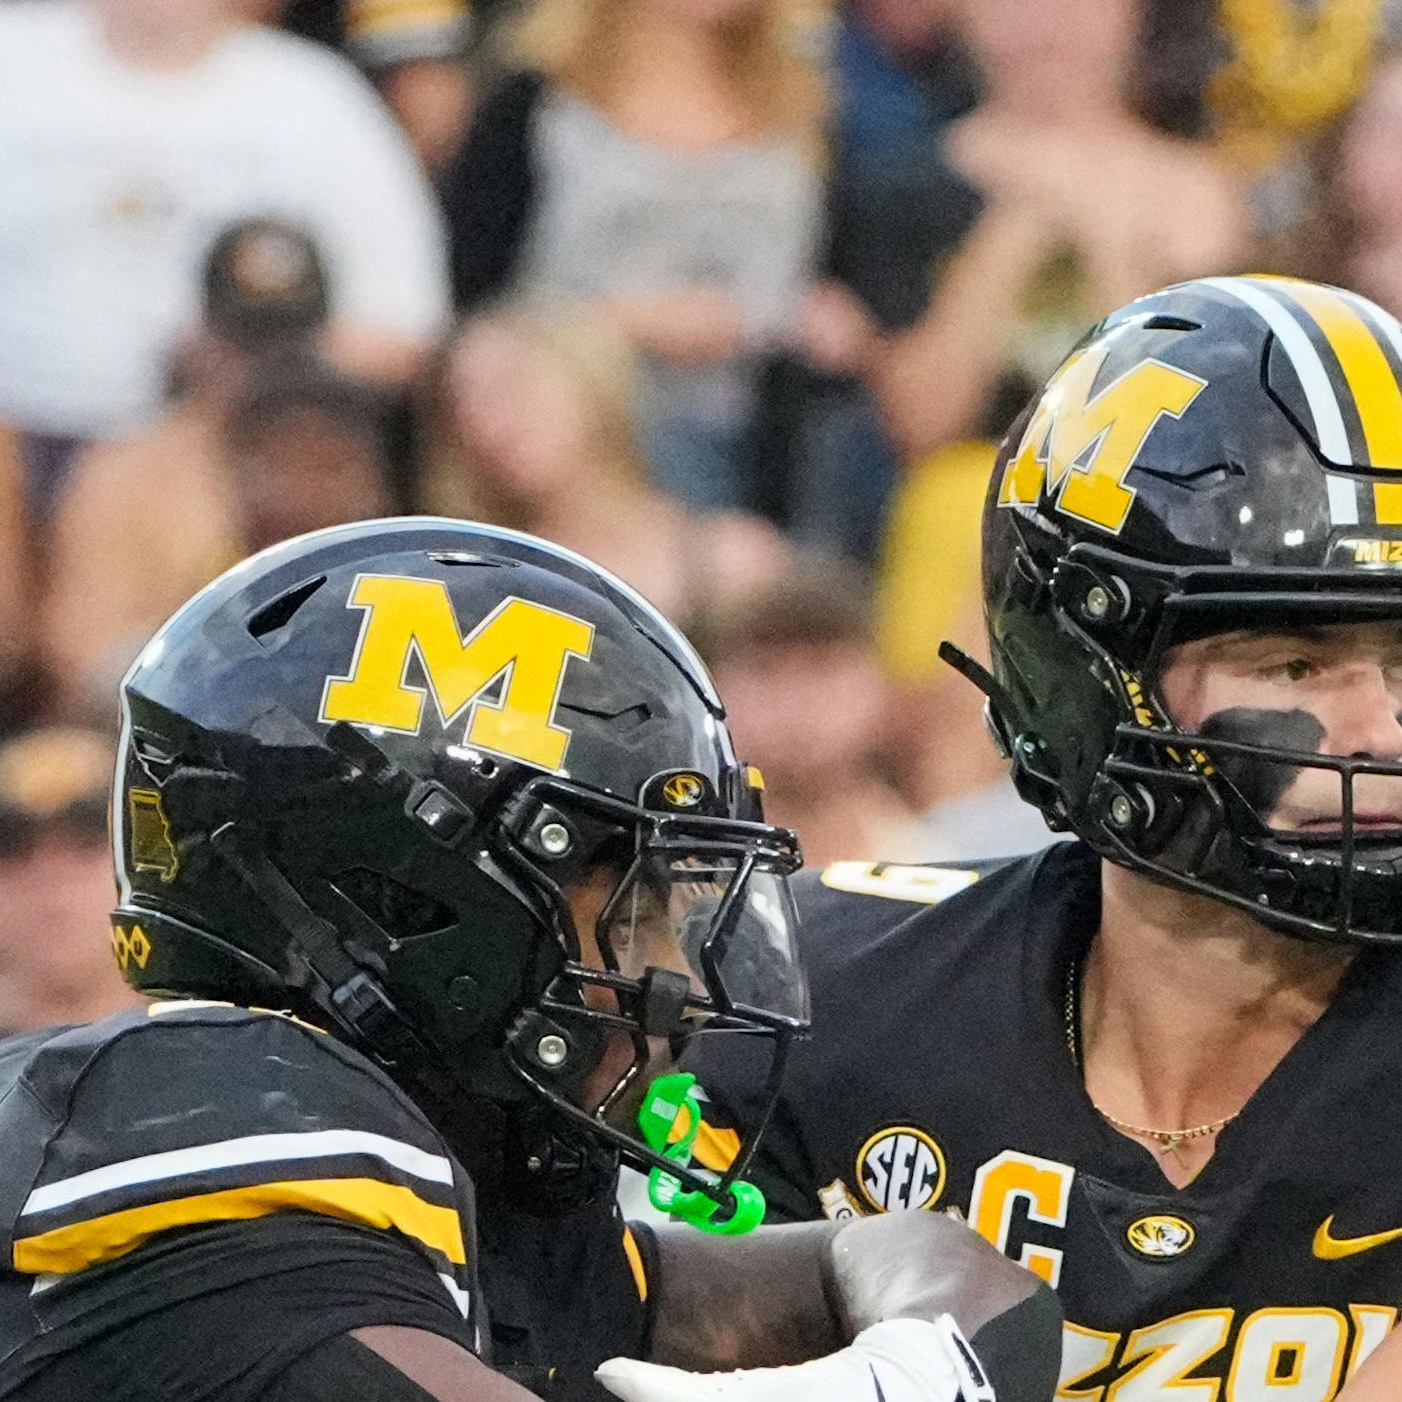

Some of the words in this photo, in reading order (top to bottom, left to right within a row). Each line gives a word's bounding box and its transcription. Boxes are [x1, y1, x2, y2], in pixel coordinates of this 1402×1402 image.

[998, 357, 1208, 535] M
[319, 572, 595, 772] M
[863, 1133, 938, 1210] SEC
[967, 1149, 1075, 1291] C
